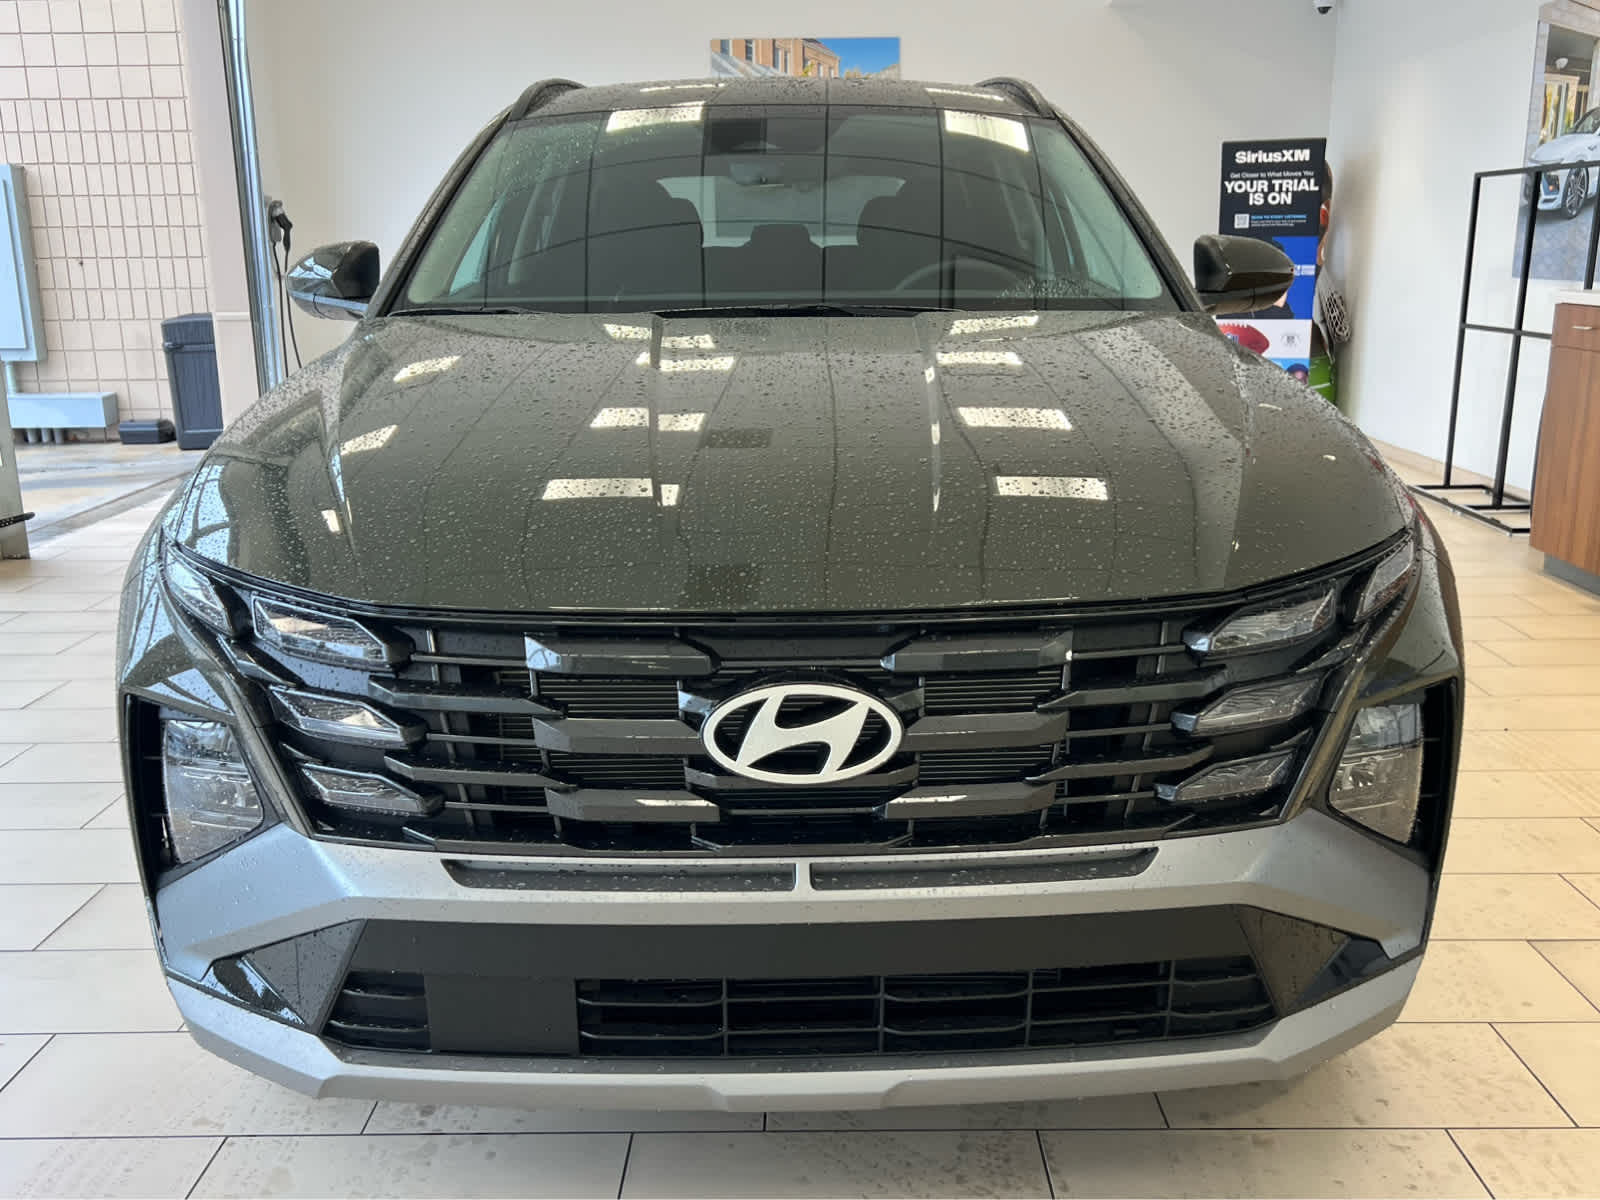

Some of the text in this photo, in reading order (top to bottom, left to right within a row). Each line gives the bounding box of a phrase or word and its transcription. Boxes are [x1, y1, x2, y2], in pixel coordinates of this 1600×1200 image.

[1235, 149, 1310, 164] SiriusXM
[1224, 178, 1319, 193] YOUR TRIAL
[1249, 192, 1292, 205] IS ON
